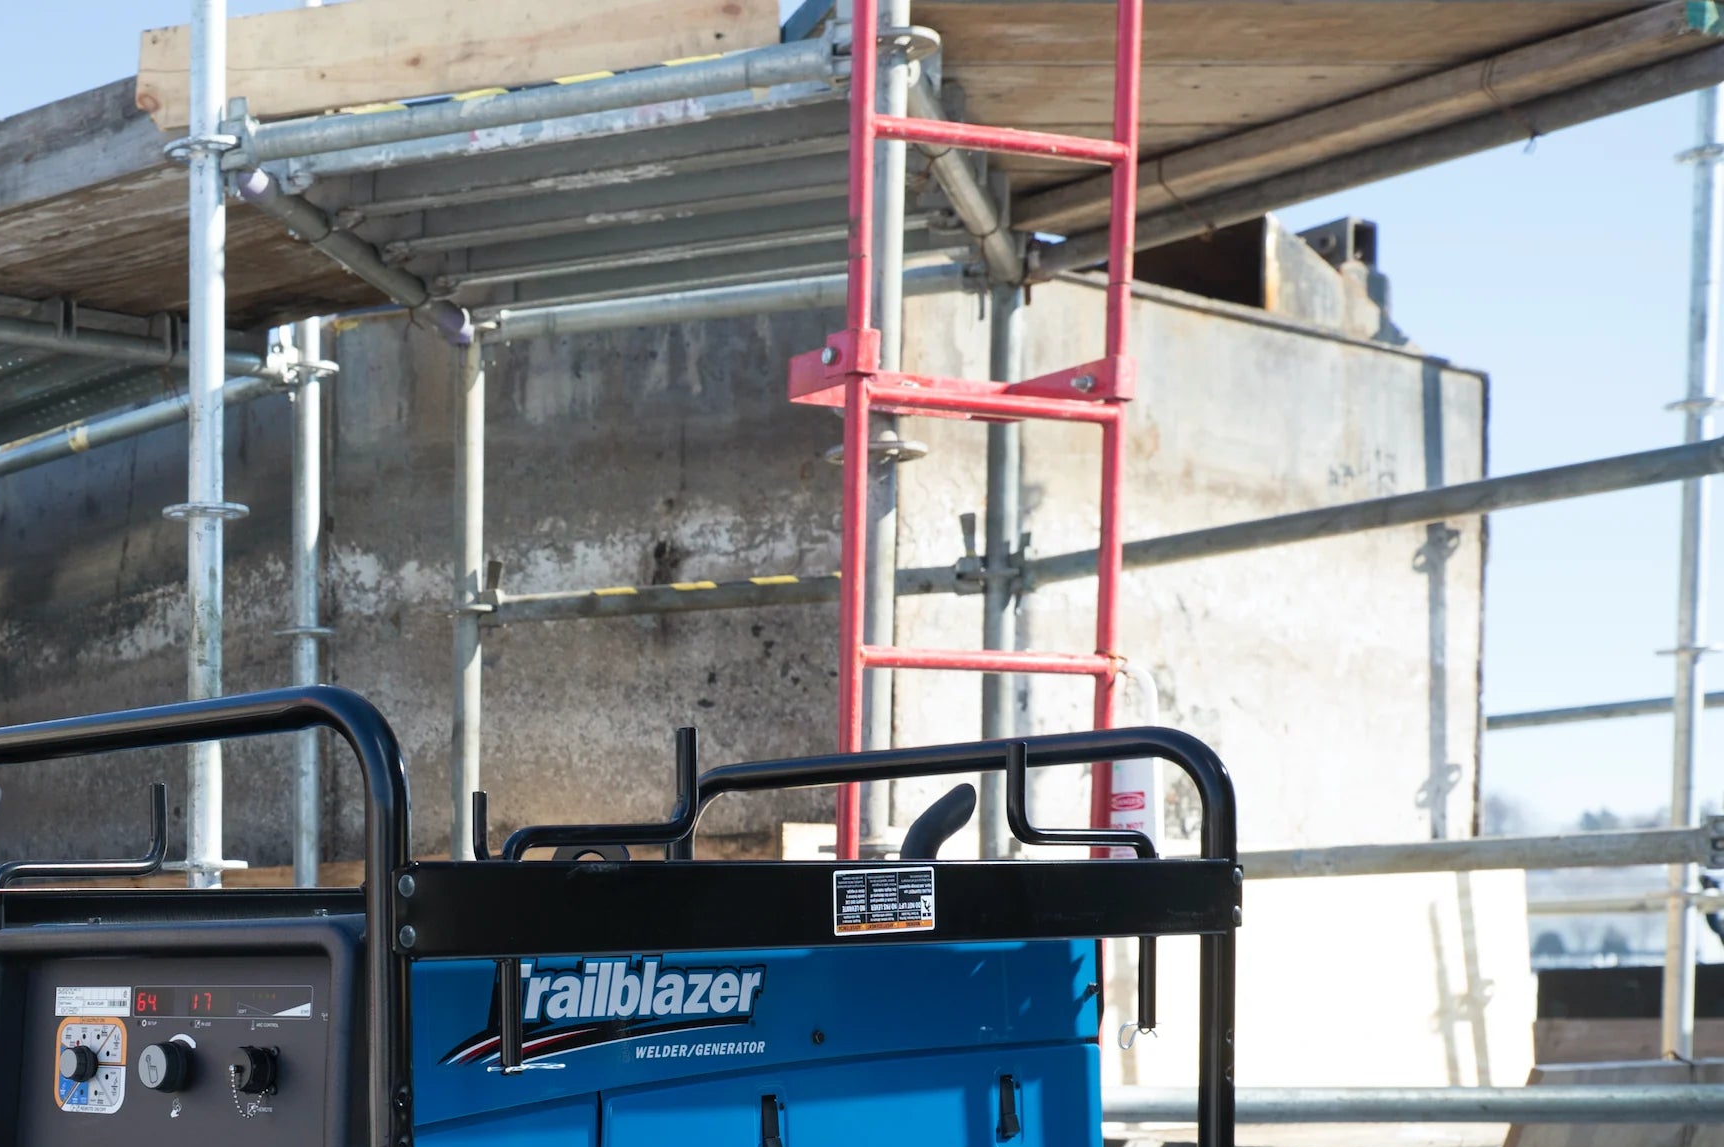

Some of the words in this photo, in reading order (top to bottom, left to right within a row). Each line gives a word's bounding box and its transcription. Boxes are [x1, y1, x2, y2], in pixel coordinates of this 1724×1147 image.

[1126, 821, 1144, 829] NOT
[193, 992, 212, 1011] 17
[635, 1040, 766, 1059] WELDER/GENERATOR
